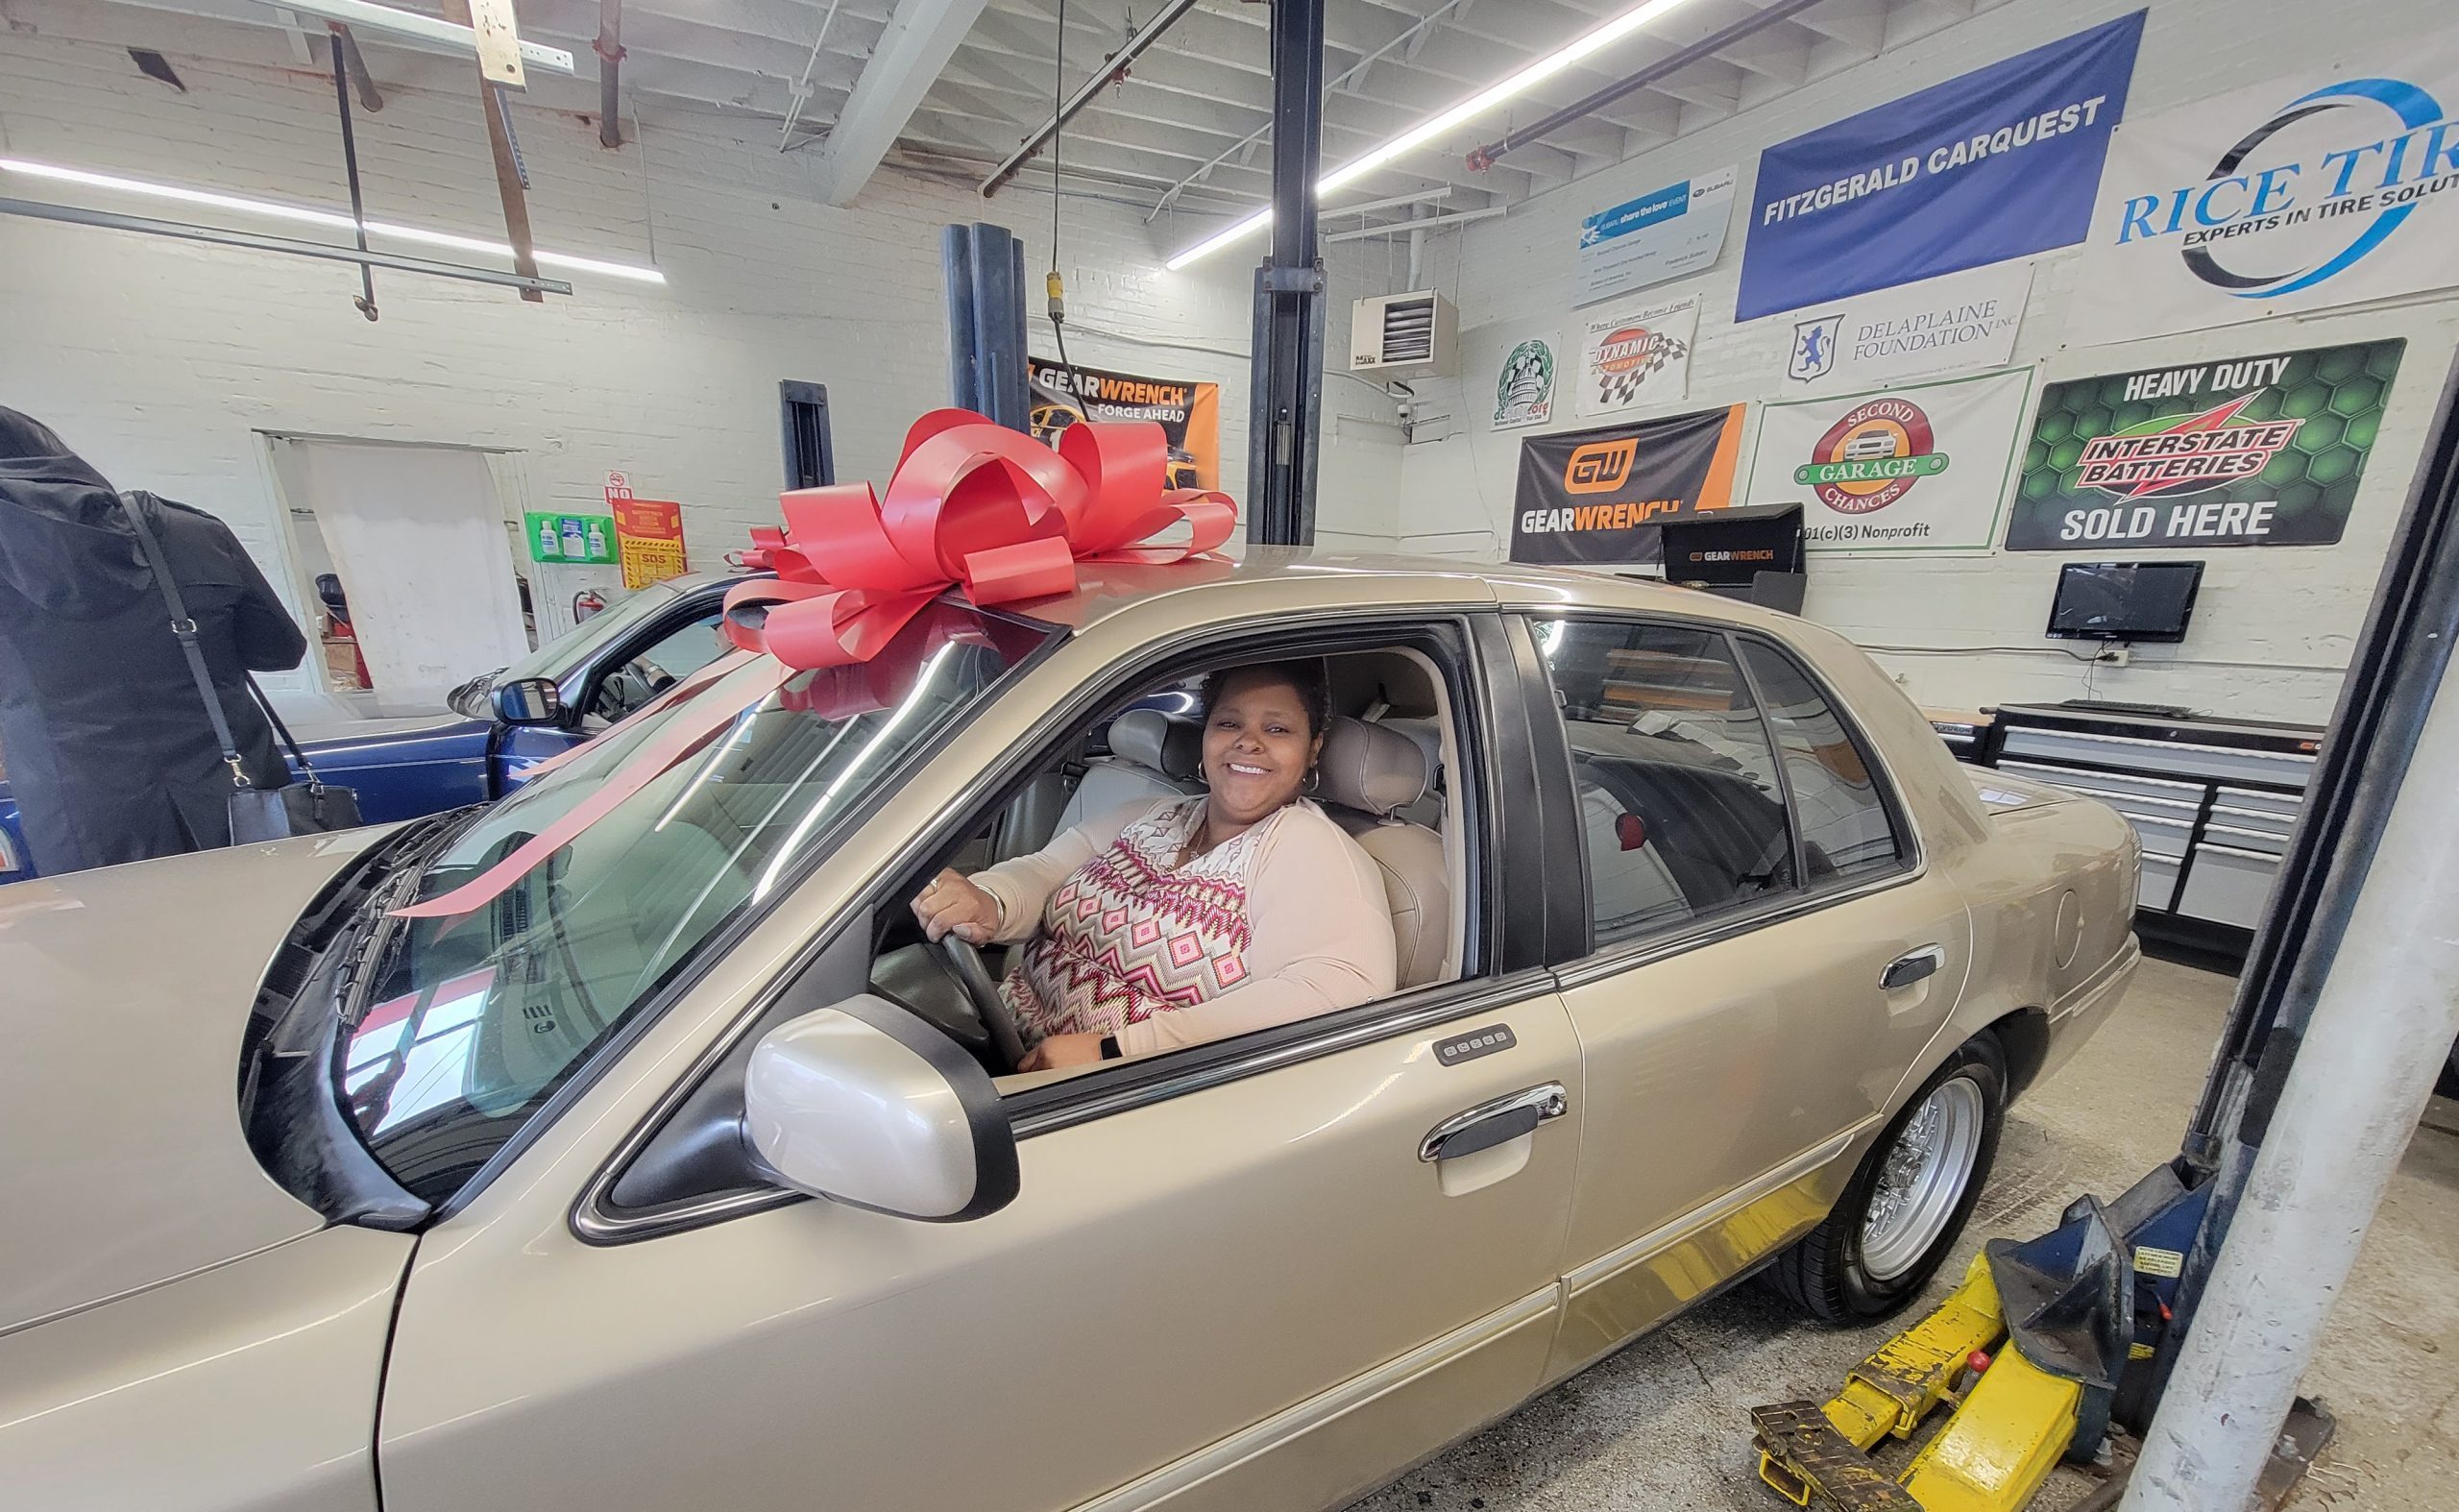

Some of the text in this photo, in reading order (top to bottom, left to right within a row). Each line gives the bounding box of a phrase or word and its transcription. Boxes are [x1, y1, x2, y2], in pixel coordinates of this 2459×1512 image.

[1764, 94, 2106, 227] FITZGERALD CARQUEST
[1620, 210, 1640, 224] share
[1641, 206, 1652, 216] the
[2115, 163, 2301, 246] RICE
[2182, 214, 2280, 247] EXPERTS
[2285, 206, 2310, 227] IN
[2317, 193, 2374, 221] TIRE
[1858, 300, 1997, 342] DELAPLAINE
[1595, 335, 1660, 364] DYNAMIC
[1854, 322, 1994, 361] FOUNDATION
[1039, 368, 1184, 406] GEARWRENCH
[2123, 356, 2292, 402] HEAVY DUTY
[1098, 403, 1185, 424] FORGE AHEAD
[1847, 402, 1914, 427] SECOND
[2086, 426, 2289, 461] INTERSTATE
[1819, 458, 1917, 481] GARAGE
[2086, 451, 2264, 482] BATTERIES
[1825, 483, 1900, 511] CHANCES
[1804, 523, 1931, 541] 01(c)(3) Nonprofit
[2060, 501, 2277, 540] SOLD HERE
[642, 553, 667, 564] SDS
[1704, 549, 1774, 561] GEARWRENCH
